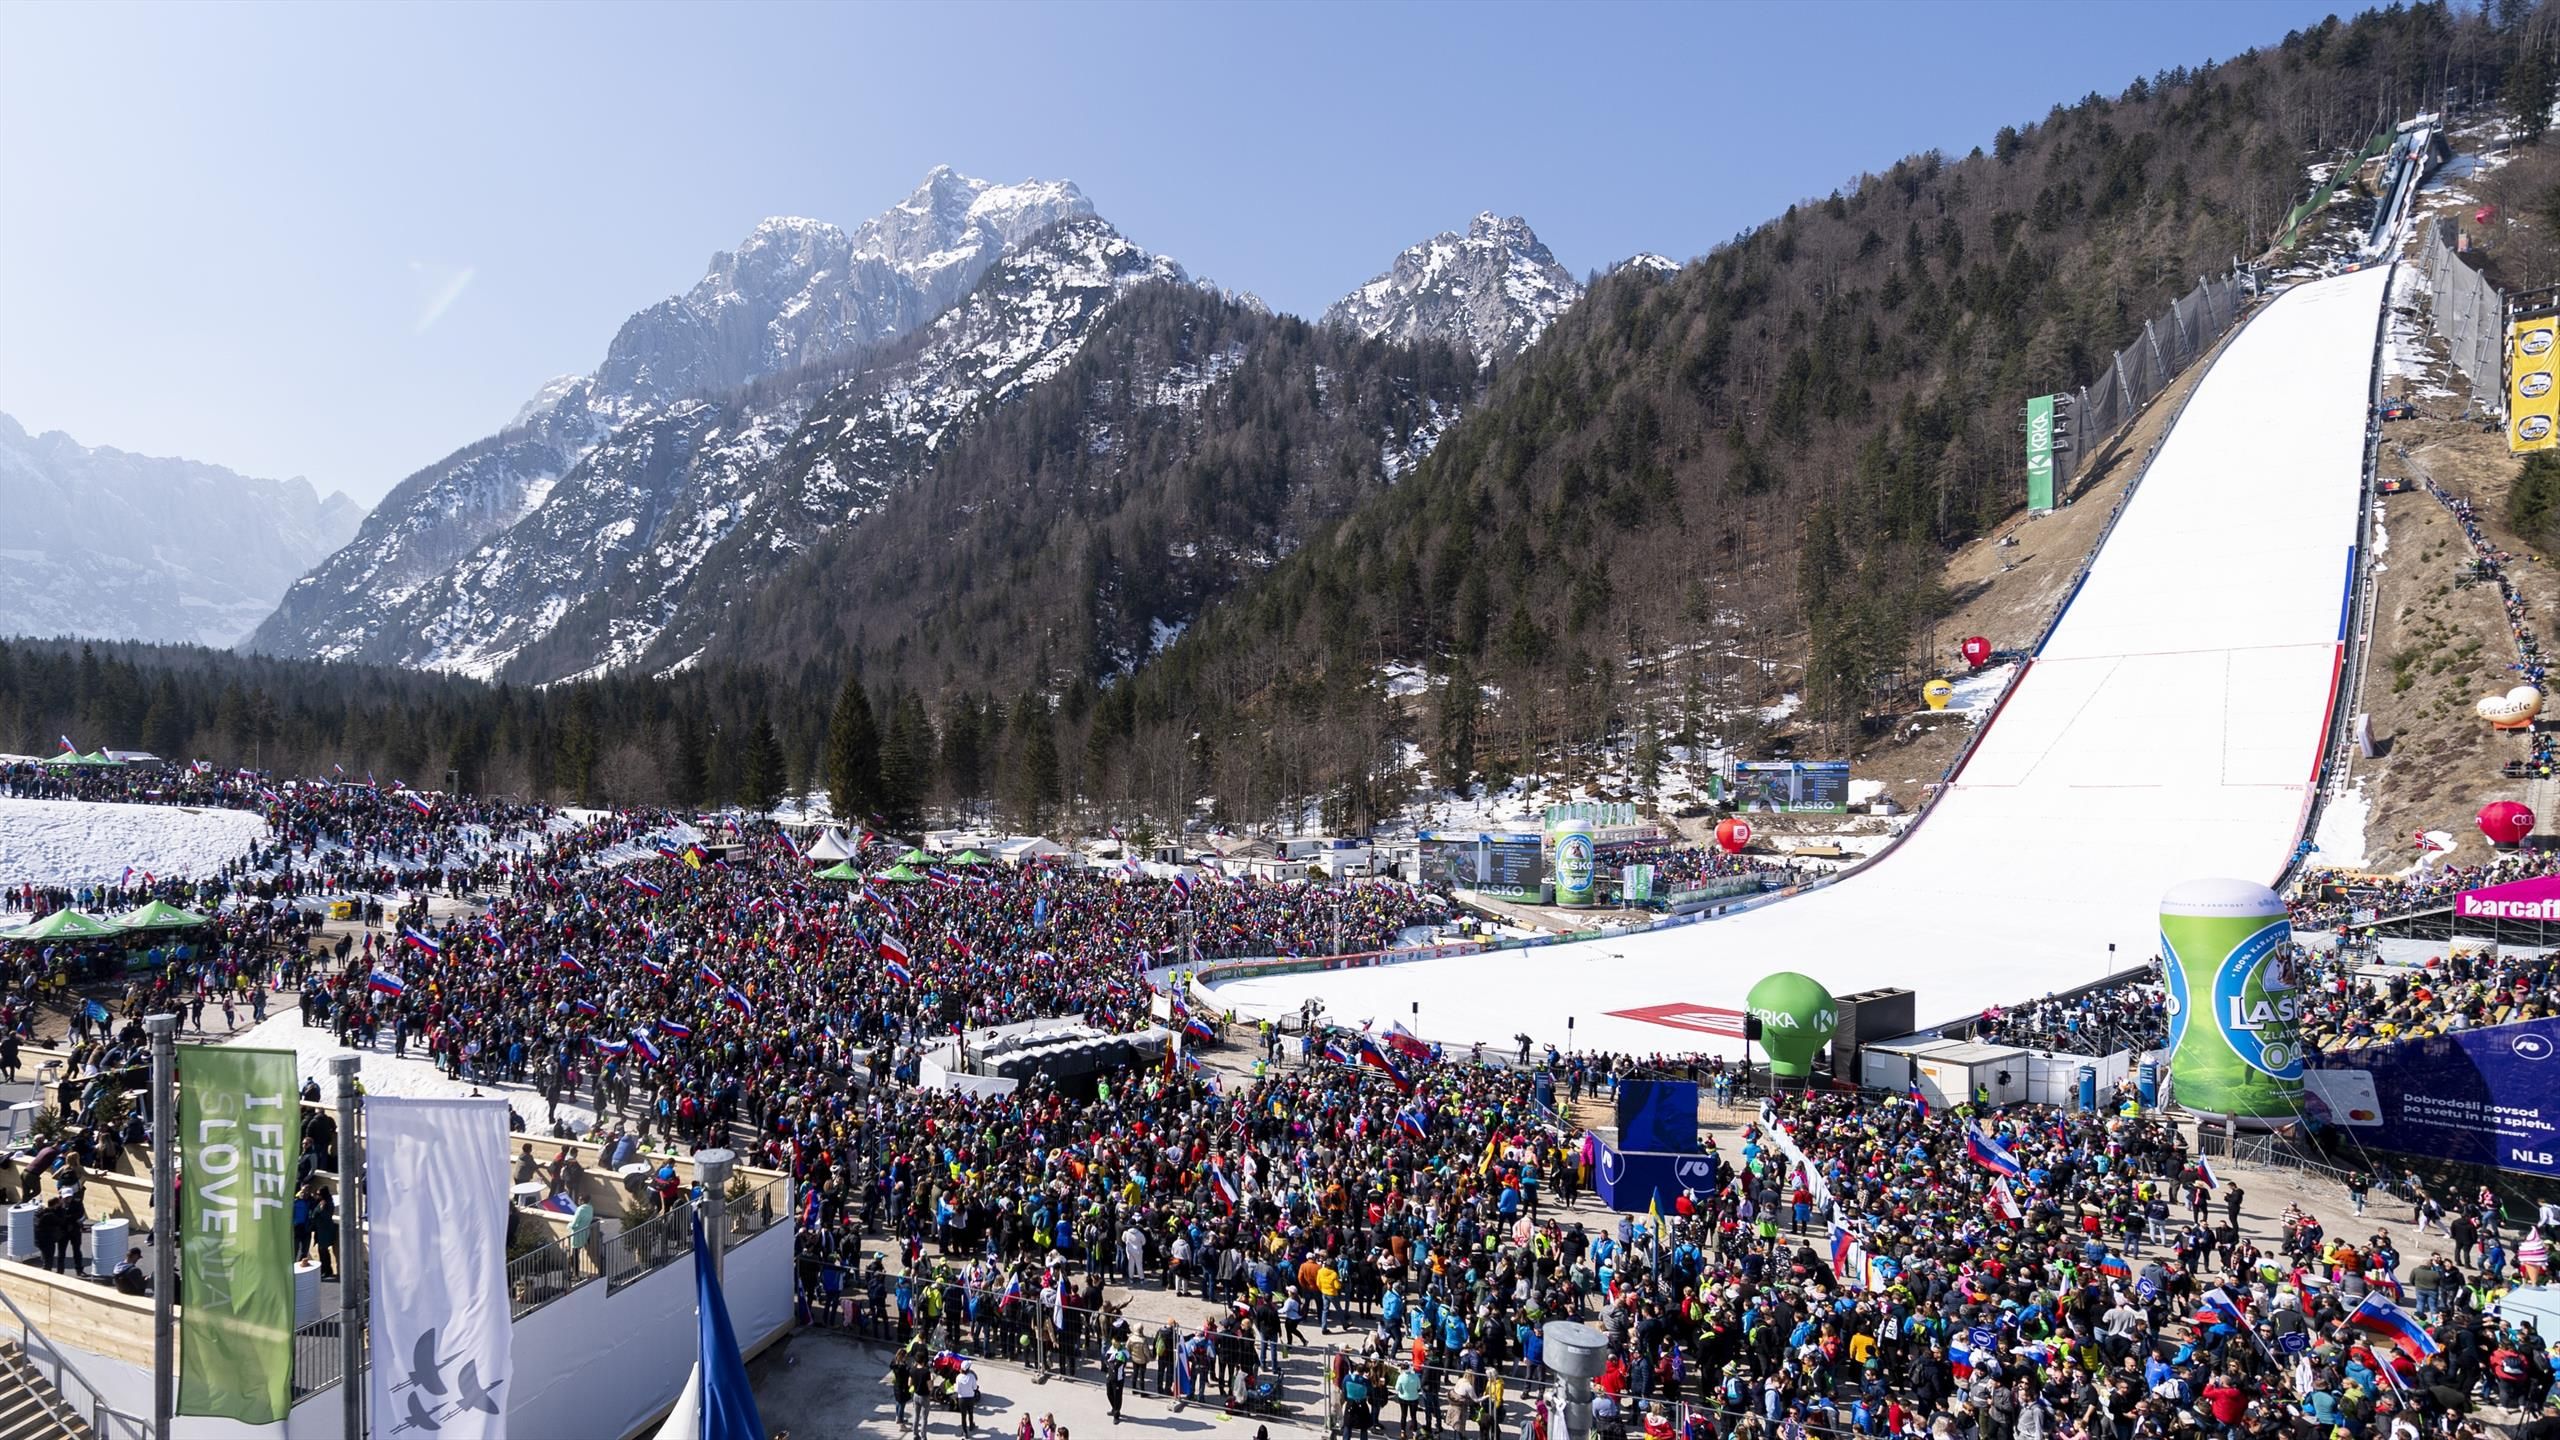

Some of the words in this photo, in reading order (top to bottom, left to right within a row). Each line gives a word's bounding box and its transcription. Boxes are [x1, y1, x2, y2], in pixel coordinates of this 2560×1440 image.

[2032, 411, 2049, 452] KRKA
[244, 1093, 283, 1110] I
[2403, 1093, 2481, 1111] Dobrodošli
[2484, 1104, 2539, 1119] povsod
[2403, 1105, 2421, 1113] po
[2424, 1107, 2462, 1119] svetu
[2466, 1110, 2479, 1121] in
[2482, 1115, 2501, 1124] na
[2504, 1116, 2556, 1131] spletu.
[2512, 1148, 2554, 1165] NLB
[247, 1122, 286, 1220] FEEL
